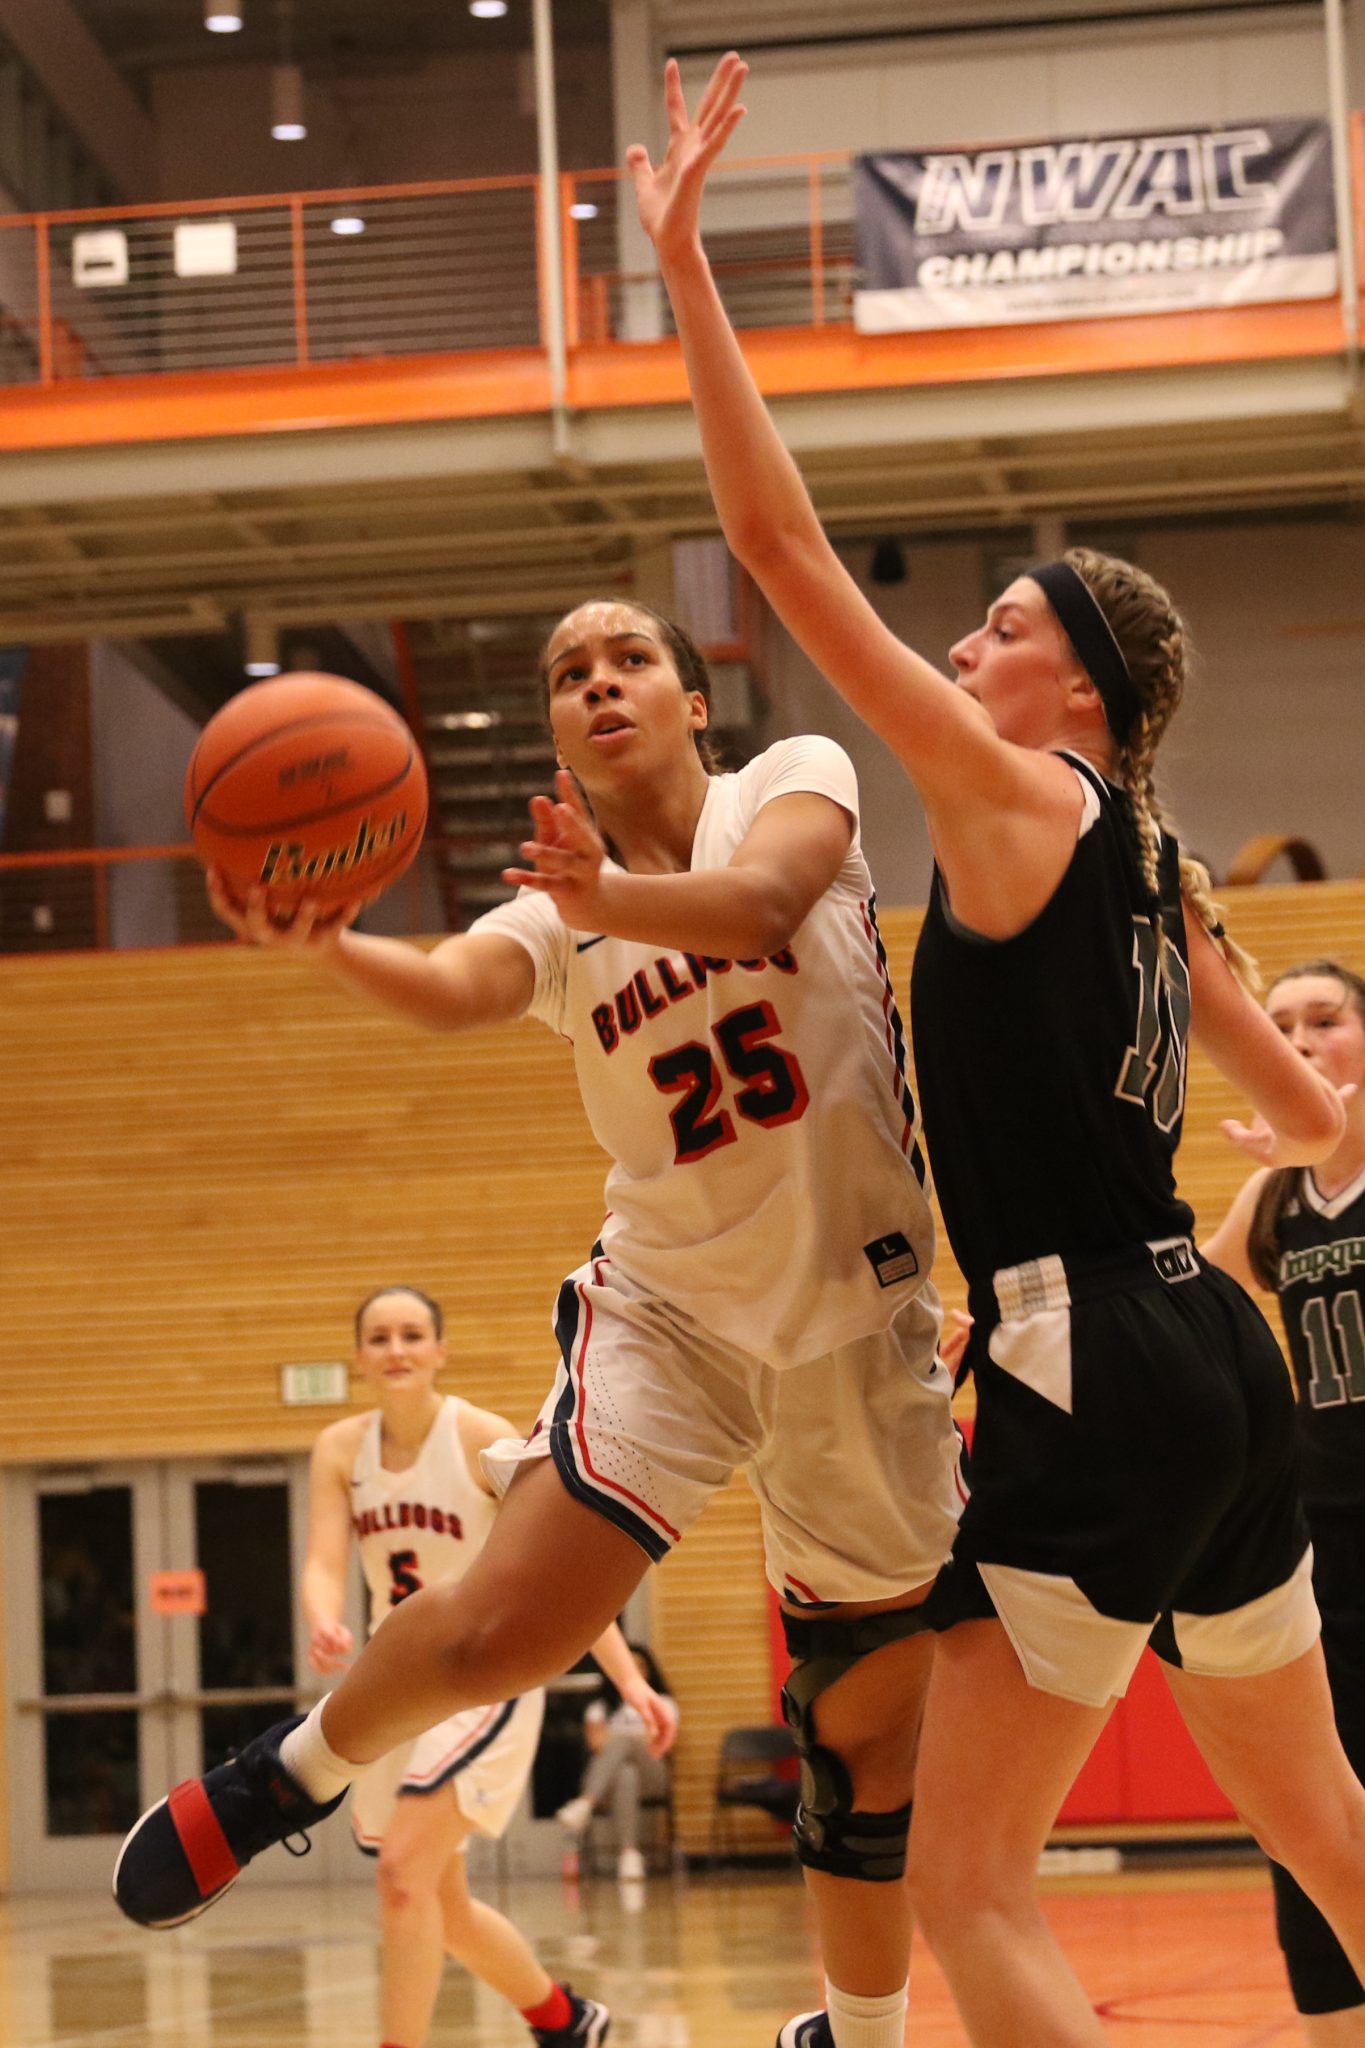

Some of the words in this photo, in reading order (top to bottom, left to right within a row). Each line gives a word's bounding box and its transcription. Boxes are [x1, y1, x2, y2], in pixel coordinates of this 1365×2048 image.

[914, 128, 1278, 236] NWAC
[918, 228, 1284, 290] CHAMPIONSHIP
[260, 811, 407, 885] Baden
[647, 999, 810, 1166] 25
[881, 1242, 896, 1255] L
[1301, 1289, 1365, 1409] 11
[388, 1549, 424, 1606] 5
